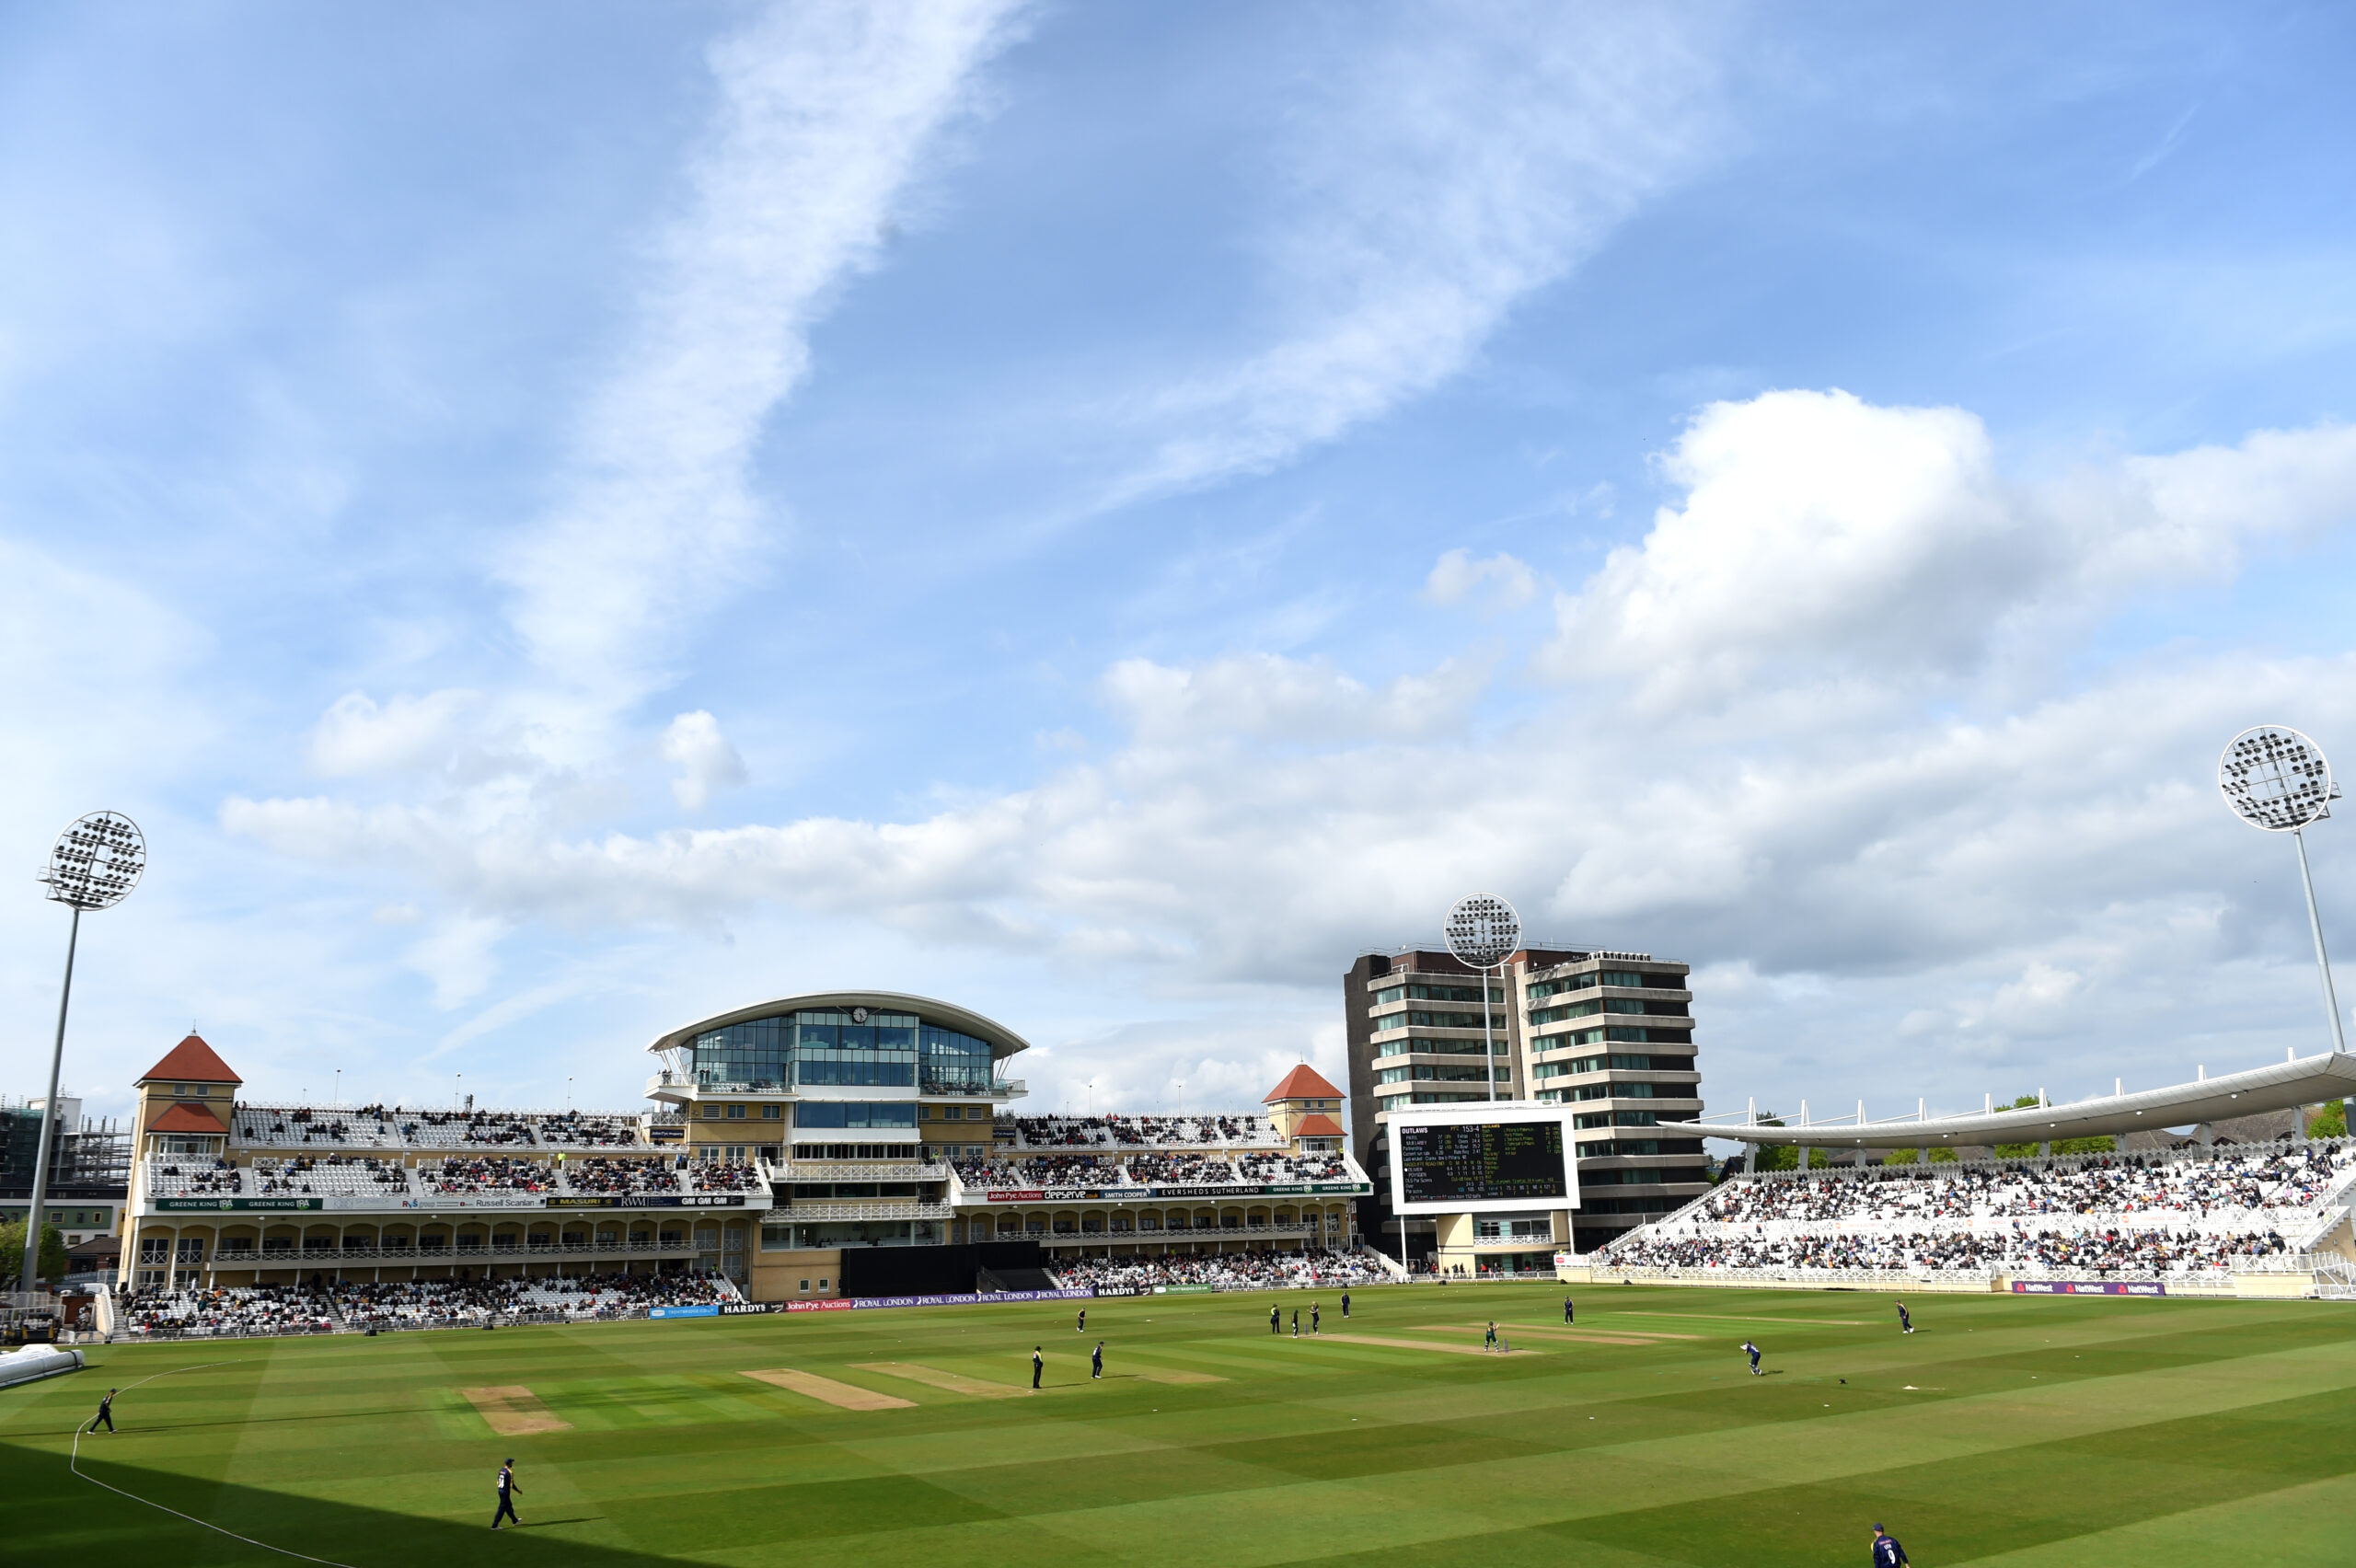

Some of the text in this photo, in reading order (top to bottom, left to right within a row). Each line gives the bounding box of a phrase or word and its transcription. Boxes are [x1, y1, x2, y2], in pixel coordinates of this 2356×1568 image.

[1005, 1192, 1016, 1200] Pye
[1161, 1187, 1259, 1196] EVERSHEDS SUTHERLAND
[219, 1199, 233, 1208] IPA
[296, 1199, 310, 1208] IPA
[620, 1197, 647, 1206] RWM
[681, 1197, 696, 1205] GM
[713, 1196, 727, 1205] GM
[2025, 1284, 2053, 1292] NatWest
[2074, 1284, 2105, 1293] NatWest
[2127, 1285, 2158, 1294] NatWest
[982, 1292, 1033, 1302] ROYAL LONDON
[1040, 1289, 1092, 1299] ROYAL LONDON
[859, 1297, 914, 1308] ROYAL LONDON
[922, 1295, 976, 1305] ROYAL LONDON
[786, 1300, 850, 1310] John Pye Auctions
[1888, 1549, 1896, 1564] 9
